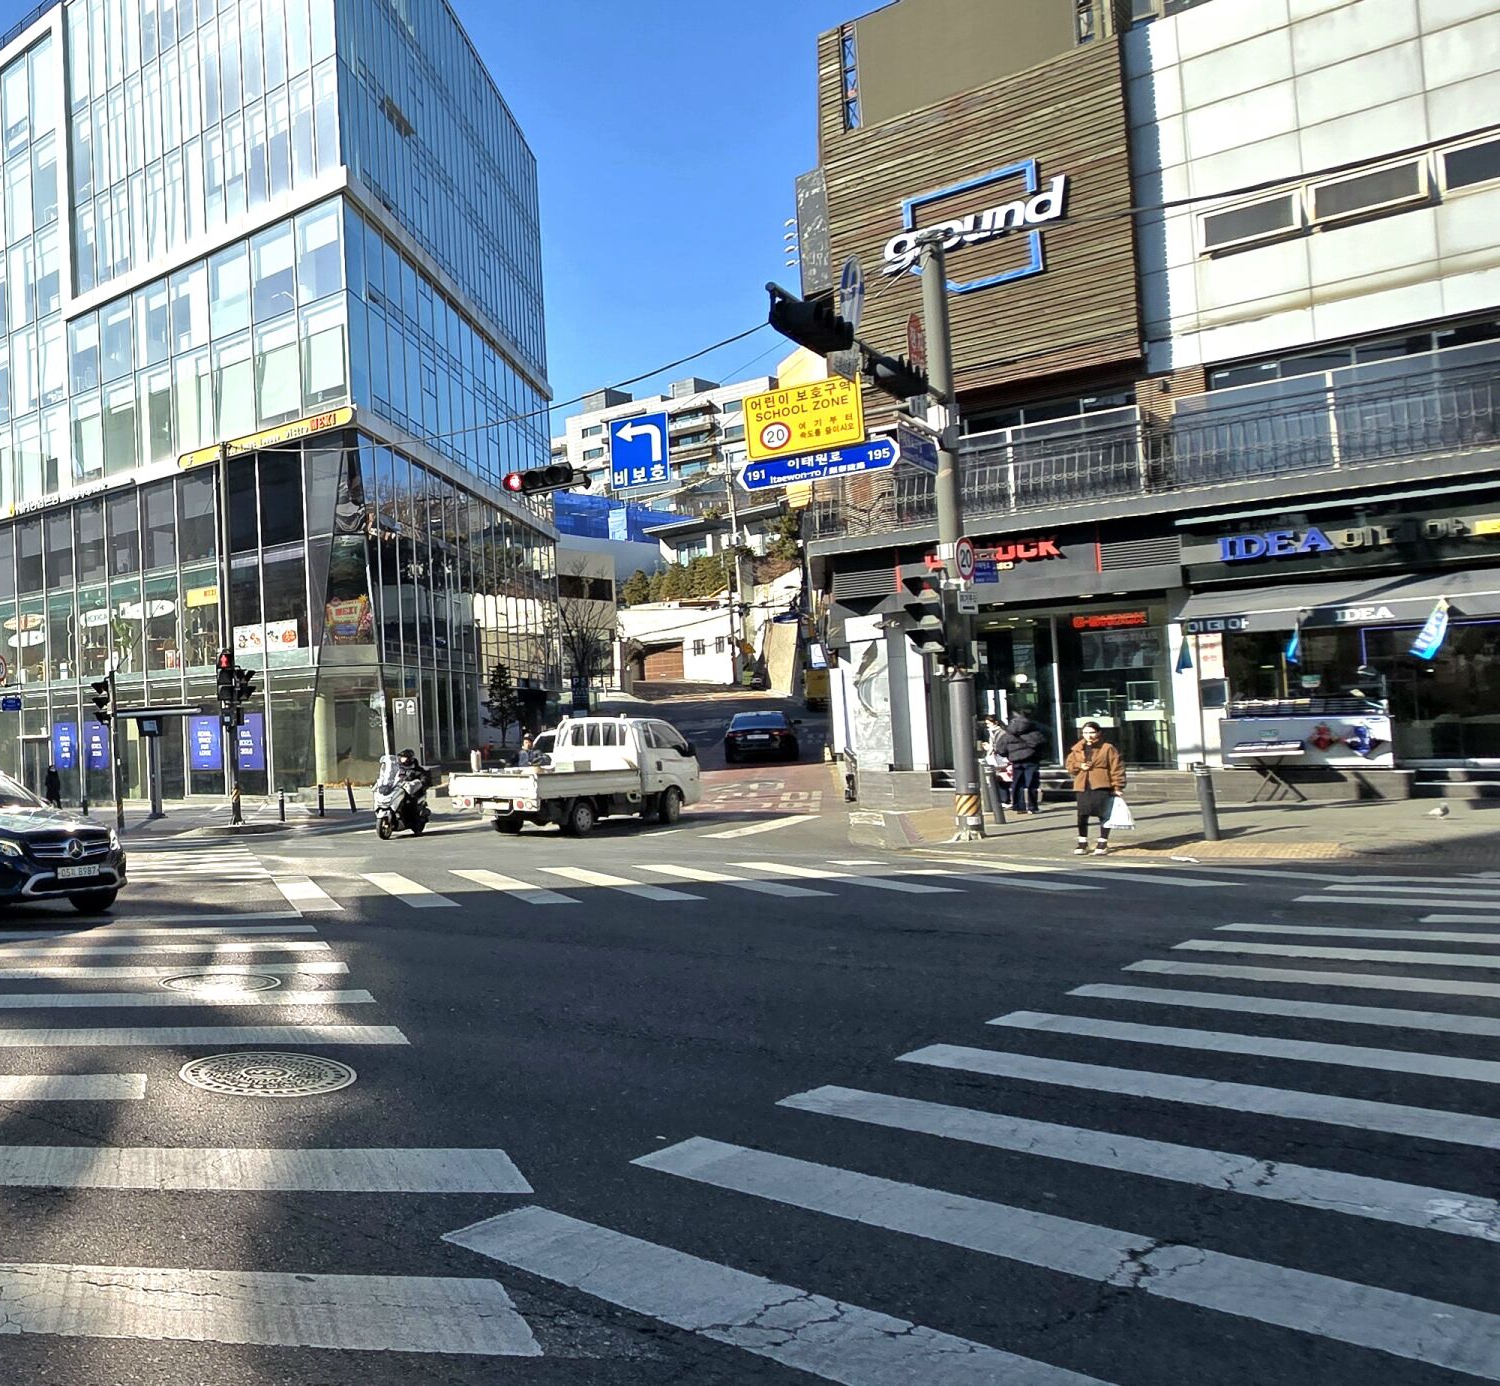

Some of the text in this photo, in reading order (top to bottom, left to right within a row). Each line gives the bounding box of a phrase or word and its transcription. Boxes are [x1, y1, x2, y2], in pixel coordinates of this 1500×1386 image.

[751, 380, 851, 410] 어린이 보호구역
[755, 395, 849, 422] SCHOOL ZONE
[766, 429, 785, 443] 20
[799, 422, 855, 438] 속도를 줄이시오
[787, 451, 843, 469] 이태원로
[867, 448, 891, 461] 195
[613, 463, 667, 487] 비보호
[747, 470, 766, 481] 191
[770, 470, 821, 484] Itaewon-ro
[1216, 526, 1334, 561] IDEA
[960, 549, 972, 568] 20
[1335, 606, 1396, 622] IDEA
[1187, 617, 1251, 633] 이디아
[394, 700, 405, 714] P
